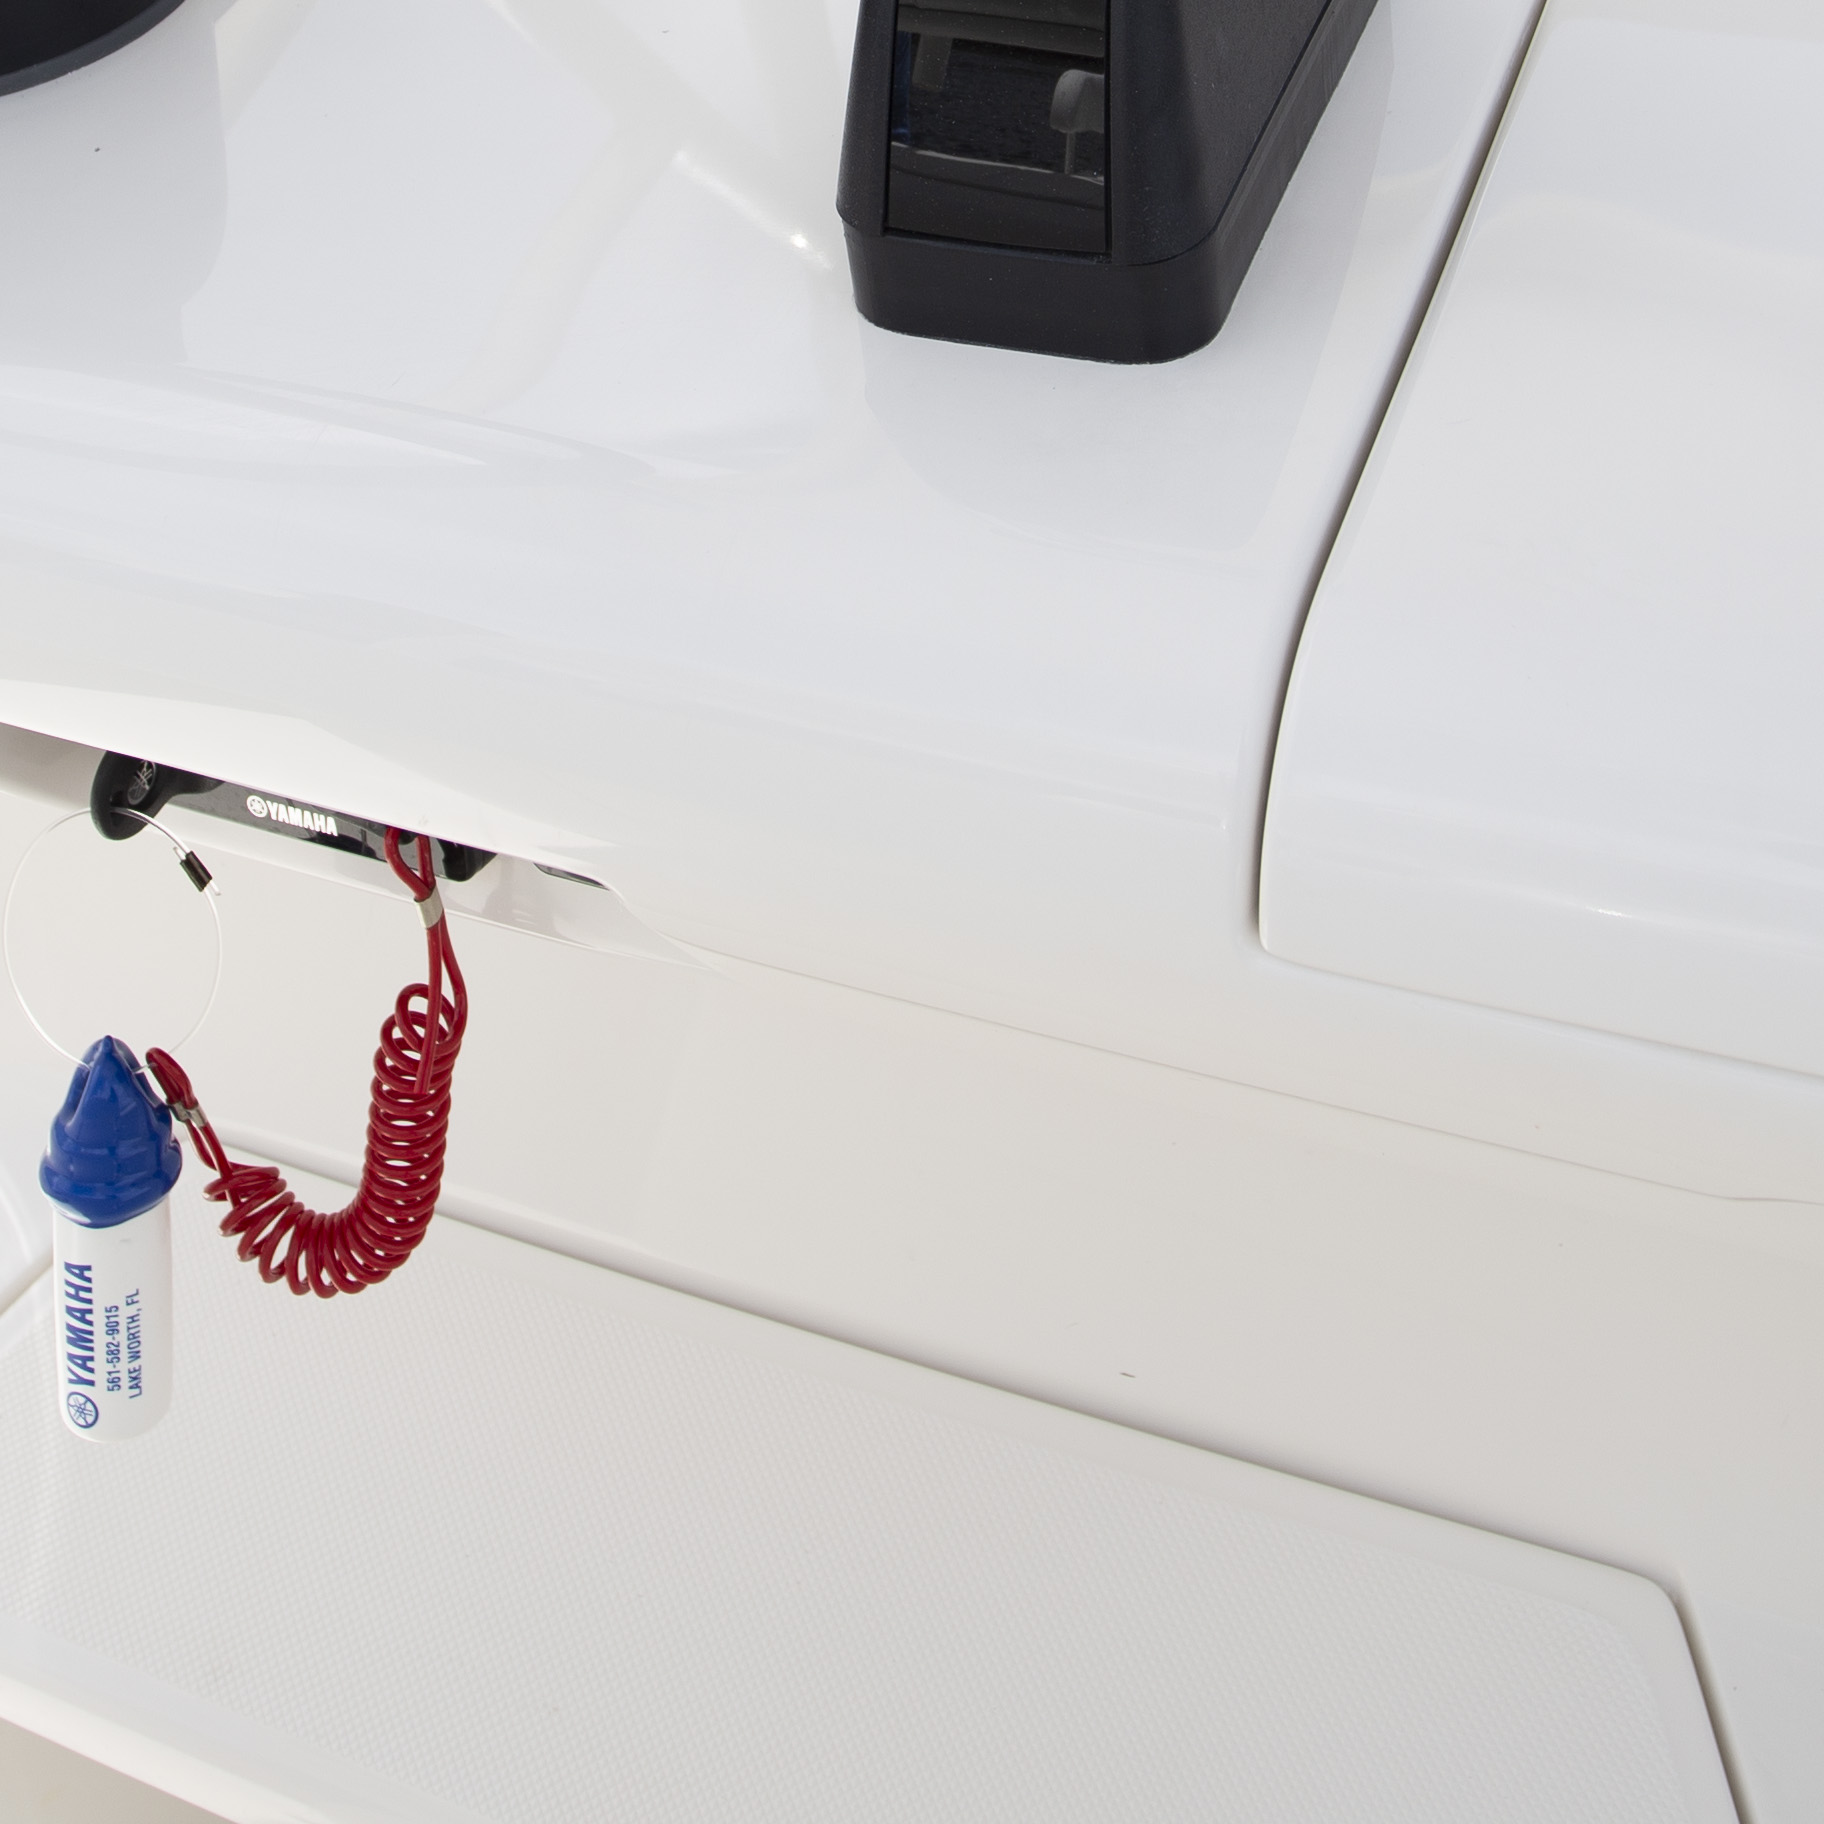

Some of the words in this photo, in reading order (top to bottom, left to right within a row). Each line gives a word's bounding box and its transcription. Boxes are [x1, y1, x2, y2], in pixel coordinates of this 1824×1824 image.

[266, 800, 338, 837] YAMAHA
[125, 1288, 140, 1306] FL
[64, 1261, 95, 1387] YAMAHA
[125, 1308, 142, 1364] WORTH,
[104, 1305, 122, 1392] 561-582-9015
[127, 1364, 142, 1399] LAKE
